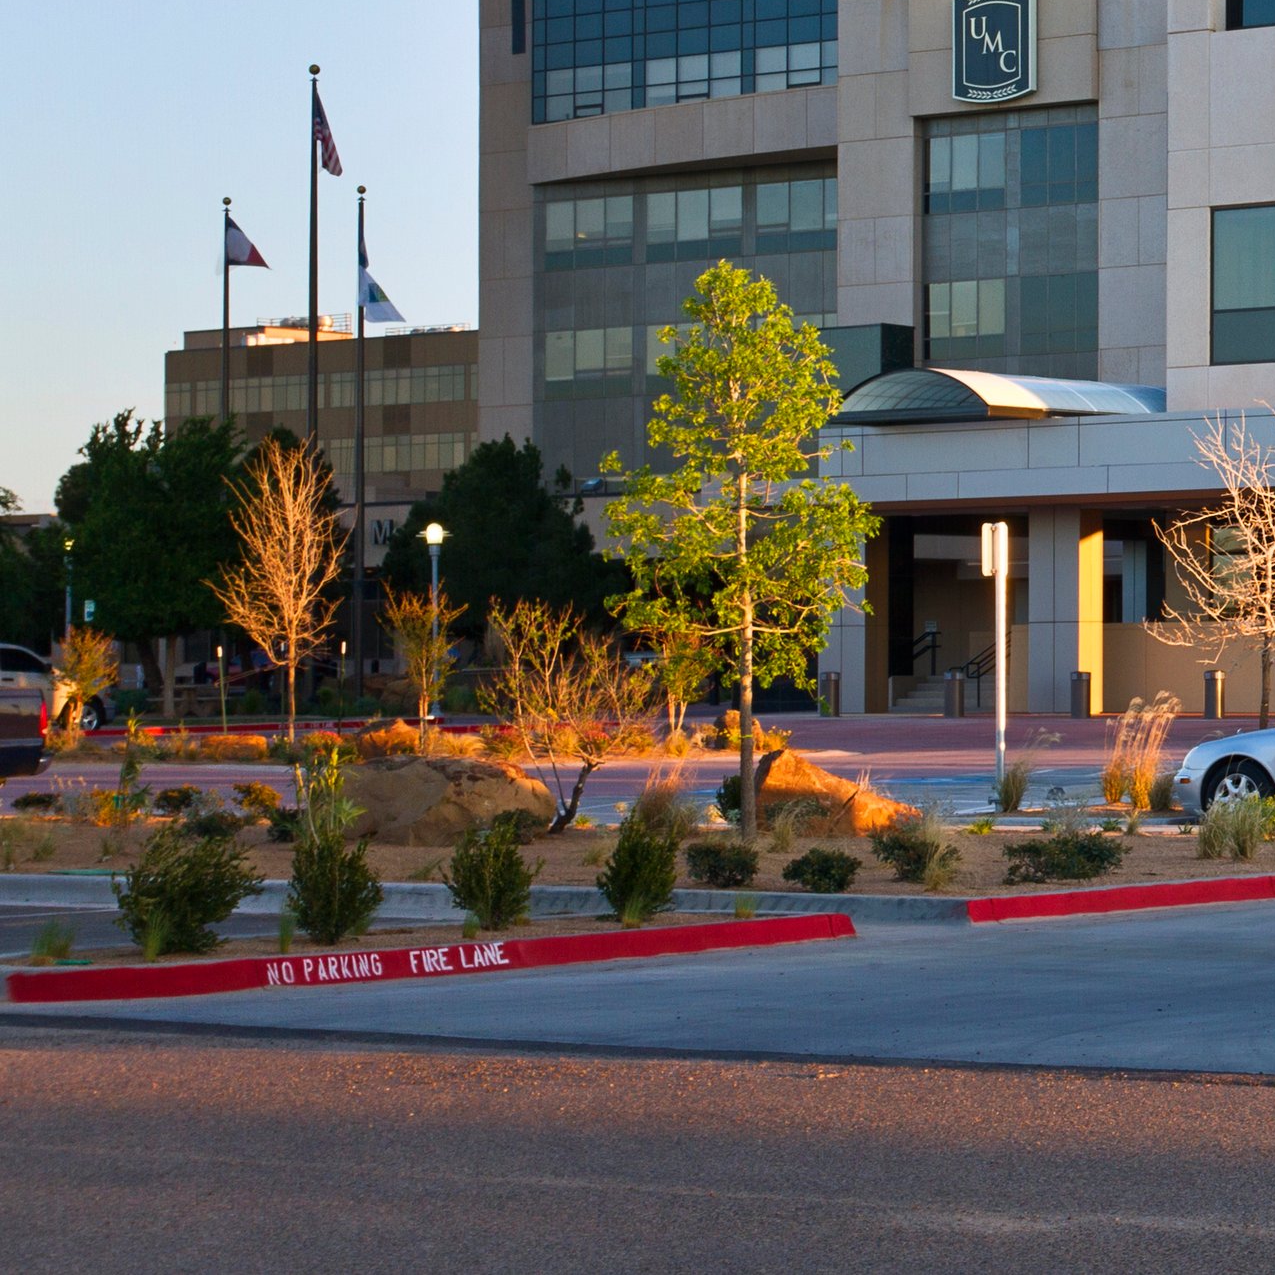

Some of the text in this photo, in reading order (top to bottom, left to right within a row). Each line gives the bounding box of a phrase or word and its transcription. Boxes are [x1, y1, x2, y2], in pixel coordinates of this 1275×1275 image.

[969, 15, 1017, 73] UMC
[266, 942, 510, 986] NO PARKING FIRE LANE
